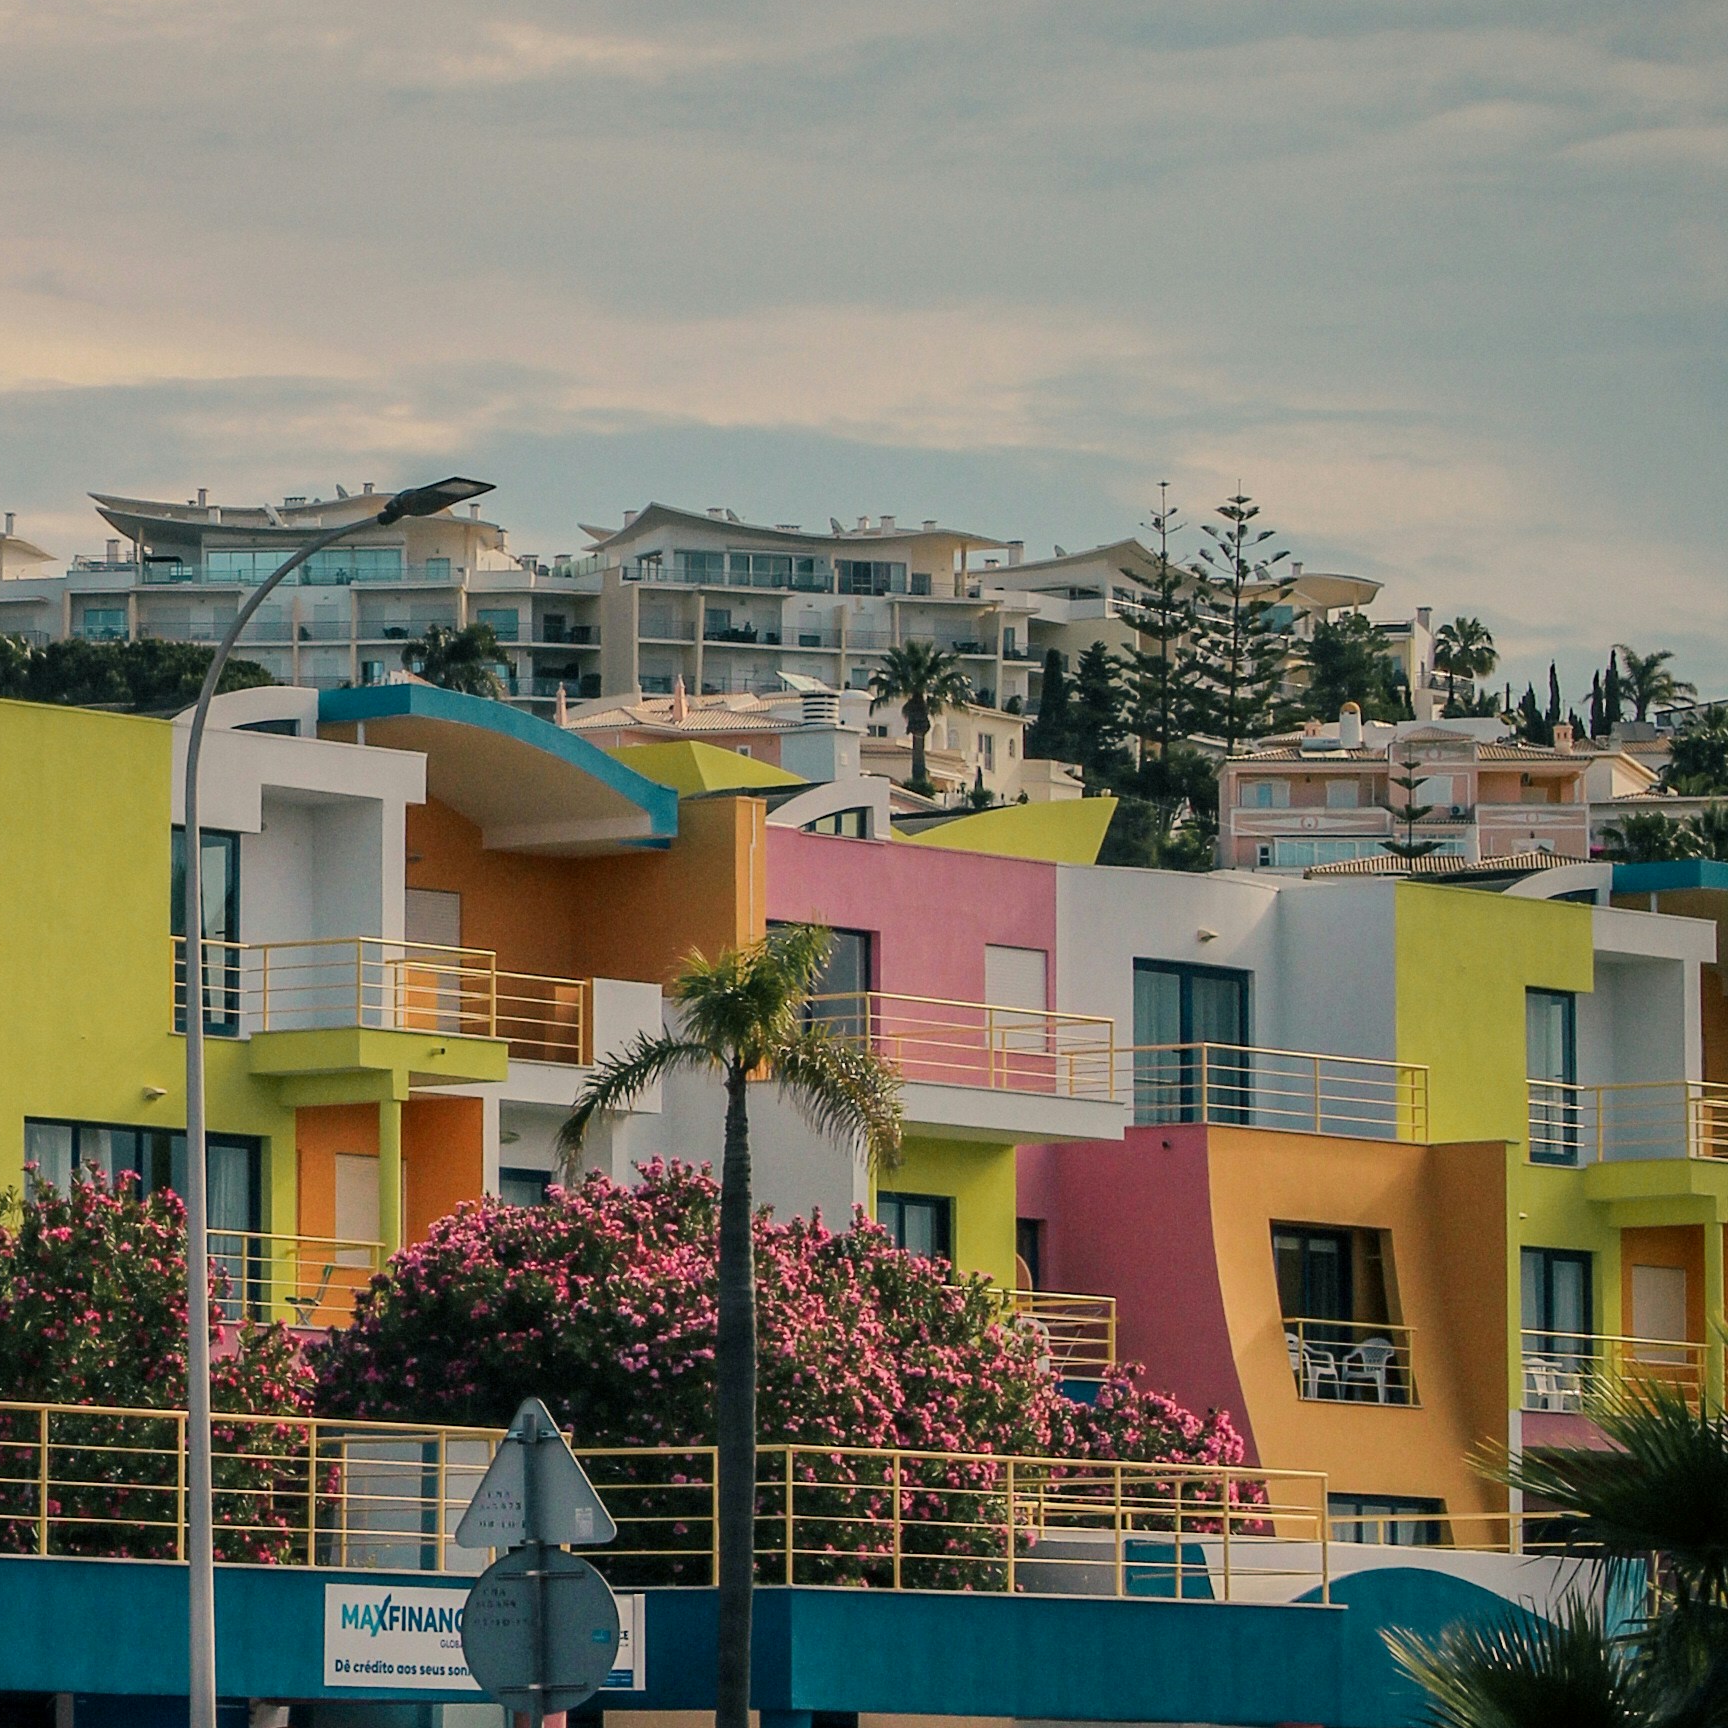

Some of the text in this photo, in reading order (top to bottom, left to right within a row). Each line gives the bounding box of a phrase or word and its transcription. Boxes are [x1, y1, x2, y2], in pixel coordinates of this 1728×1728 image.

[342, 1593, 464, 1637] MAXFINANC
[335, 1659, 351, 1673] Dê
[353, 1661, 394, 1674] crédito
[397, 1664, 417, 1675] aos
[420, 1665, 445, 1676] seus
